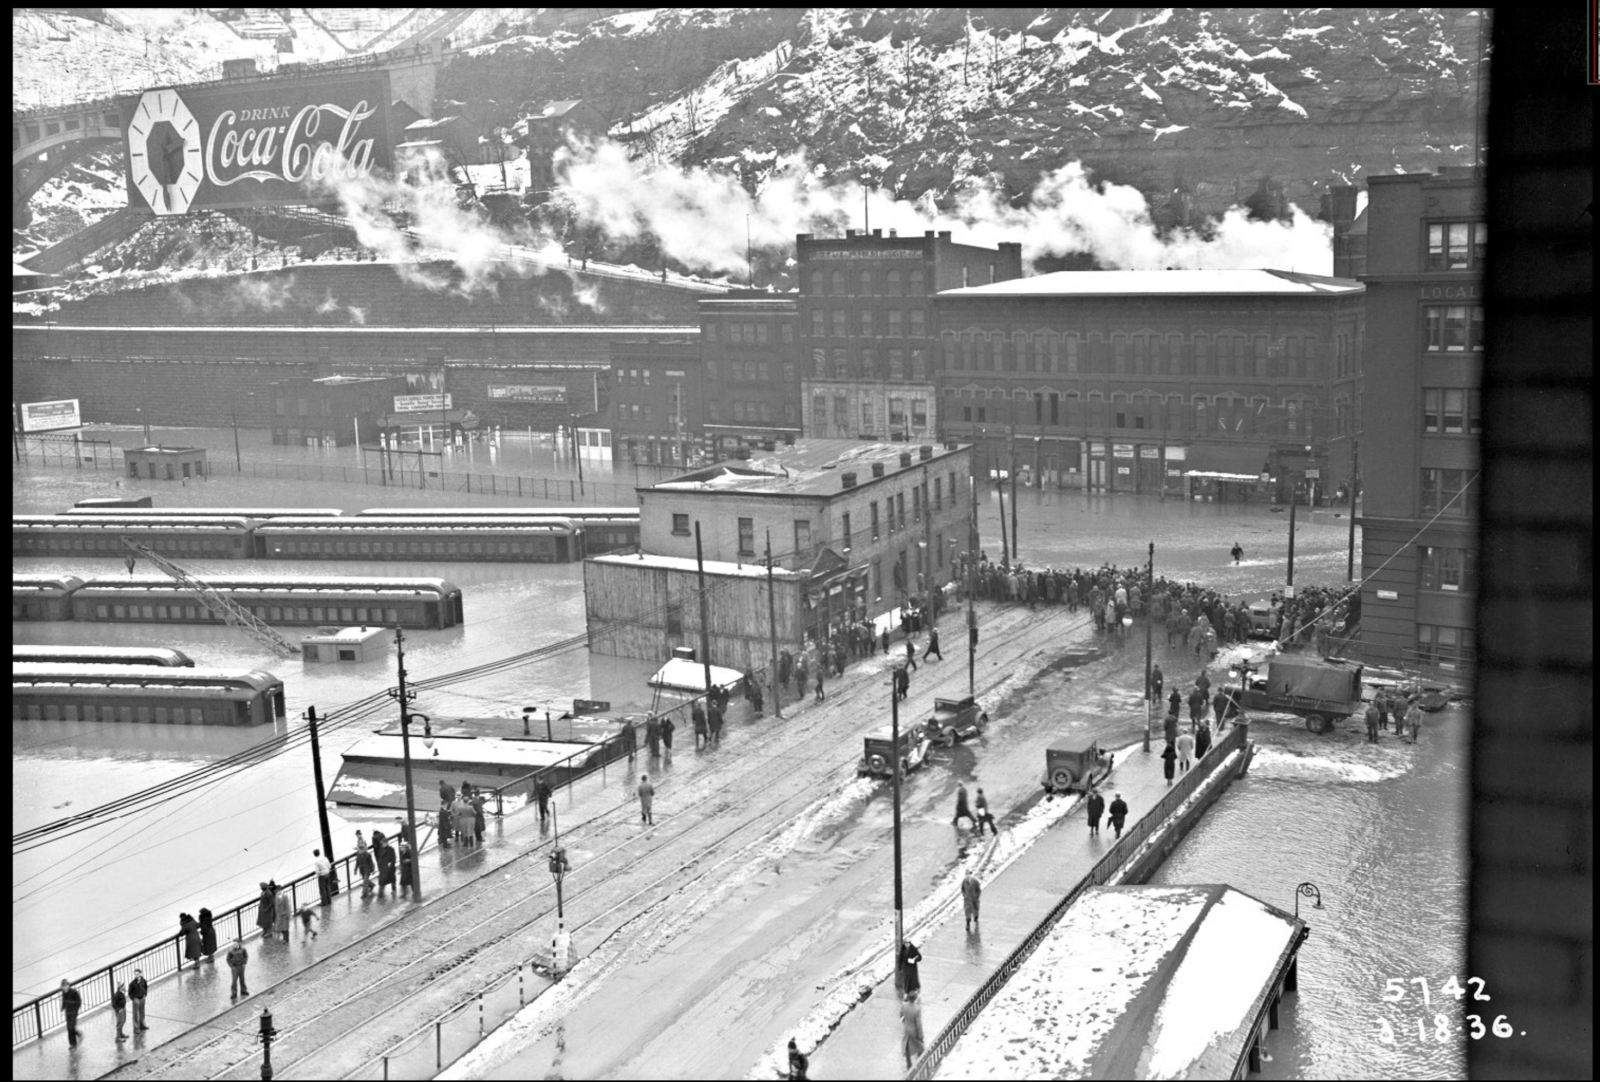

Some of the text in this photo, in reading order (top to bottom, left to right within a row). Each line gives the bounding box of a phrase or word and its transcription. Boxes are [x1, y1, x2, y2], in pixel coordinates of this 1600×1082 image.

[240, 106, 291, 122] DRINK
[206, 101, 379, 186] Coca-Cola
[1421, 286, 1478, 299] LOCAL
